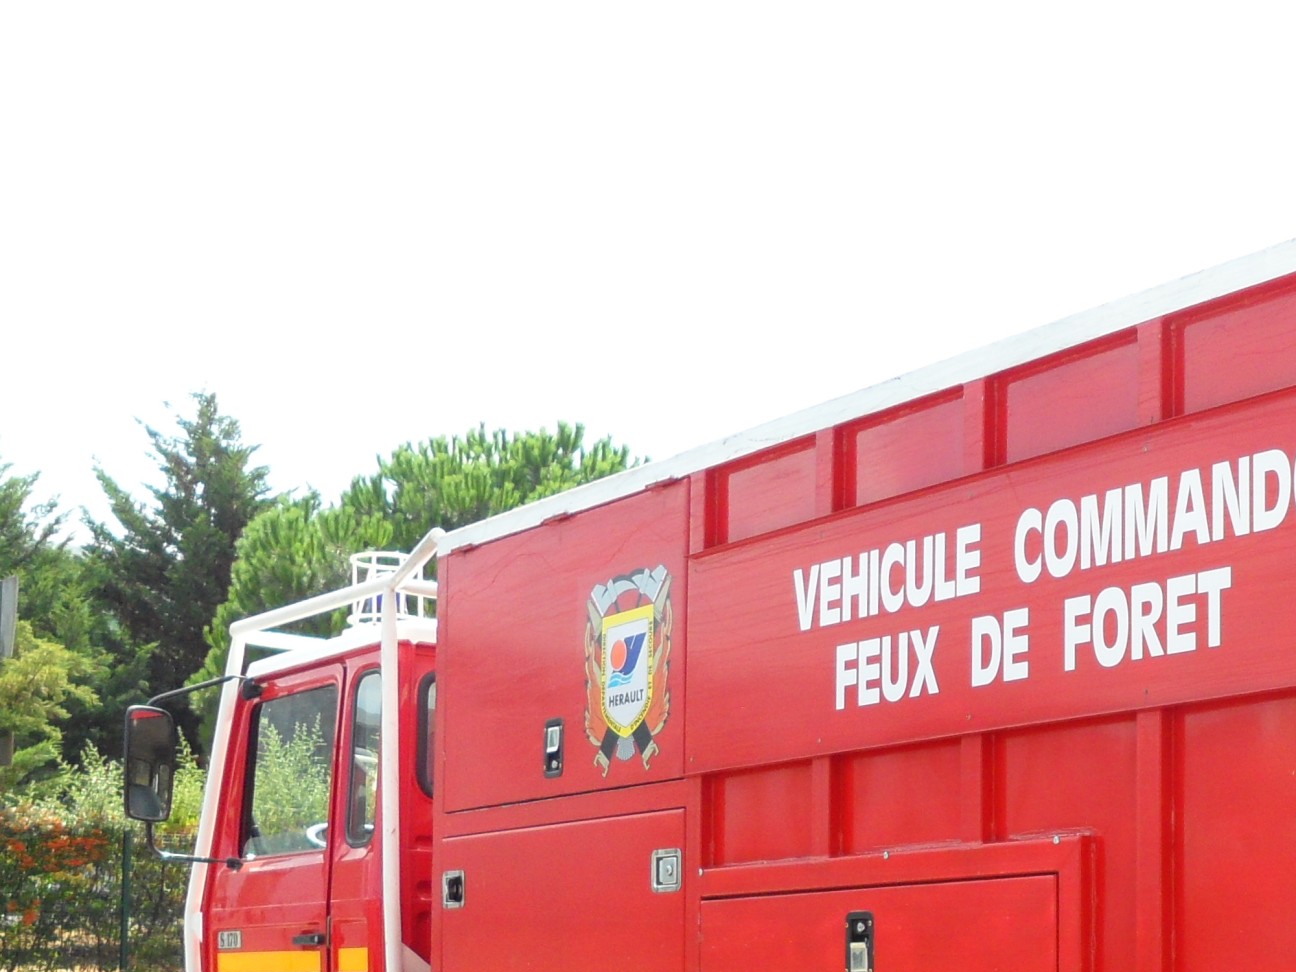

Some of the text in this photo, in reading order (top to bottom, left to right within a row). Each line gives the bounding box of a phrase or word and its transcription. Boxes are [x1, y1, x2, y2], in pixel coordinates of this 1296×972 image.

[793, 523, 981, 631] VEHICULE
[835, 566, 1232, 710] FEUX DE FORET
[608, 689, 644, 708] HERAULT
